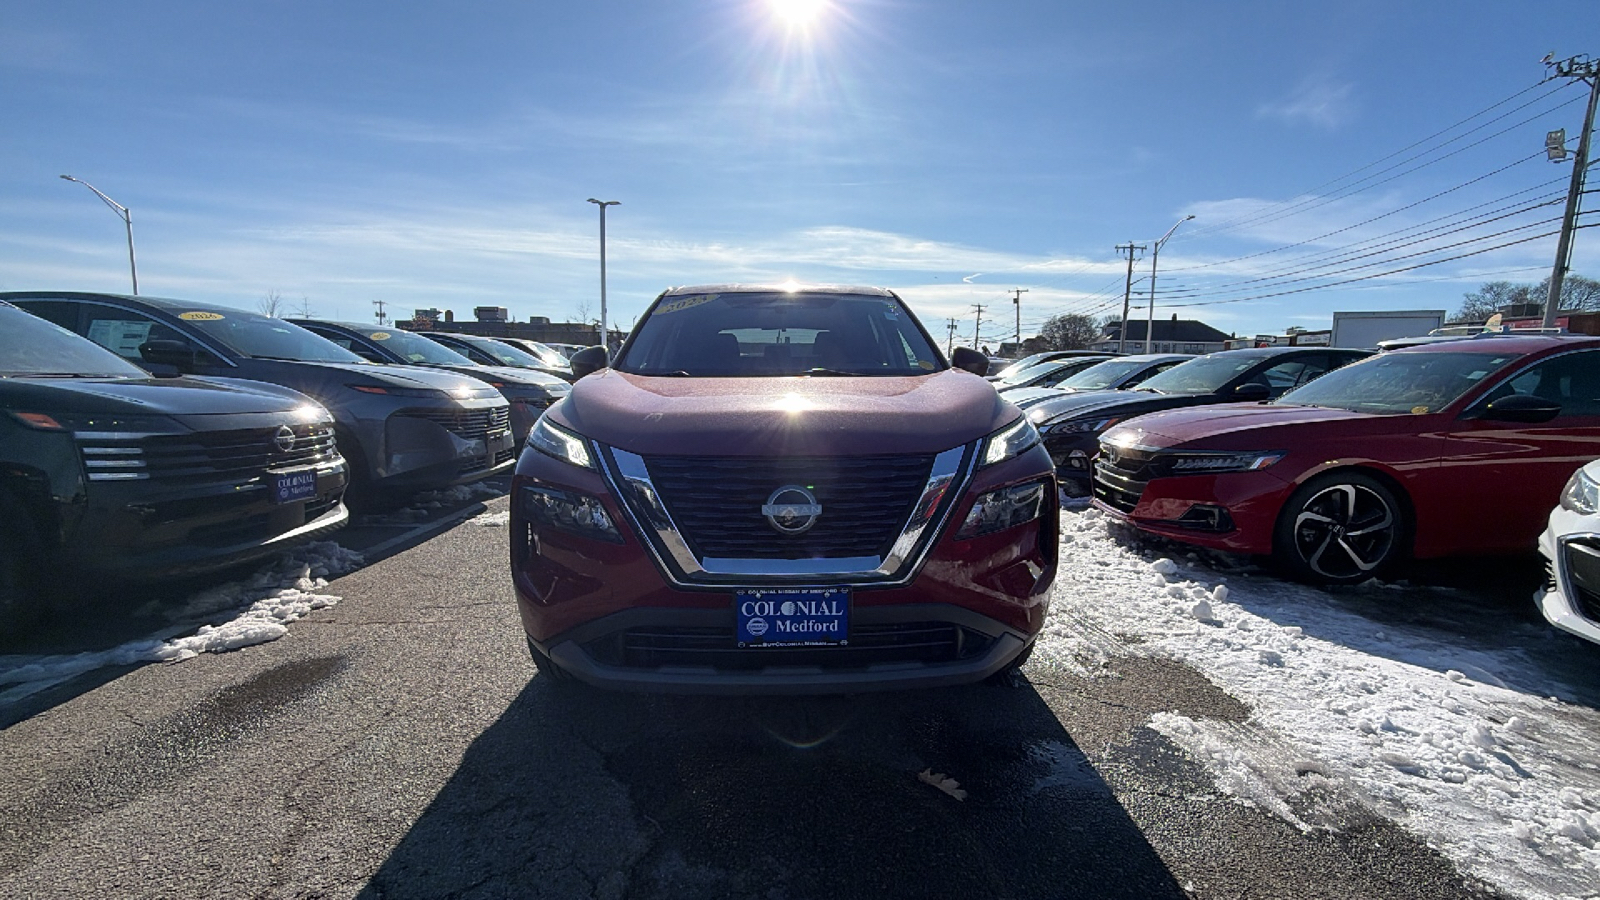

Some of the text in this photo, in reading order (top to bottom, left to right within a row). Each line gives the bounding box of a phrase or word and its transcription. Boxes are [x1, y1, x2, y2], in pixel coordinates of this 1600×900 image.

[764, 506, 820, 514] NISSAN
[741, 601, 844, 617] COLONIAL
[776, 619, 838, 633] Medford
